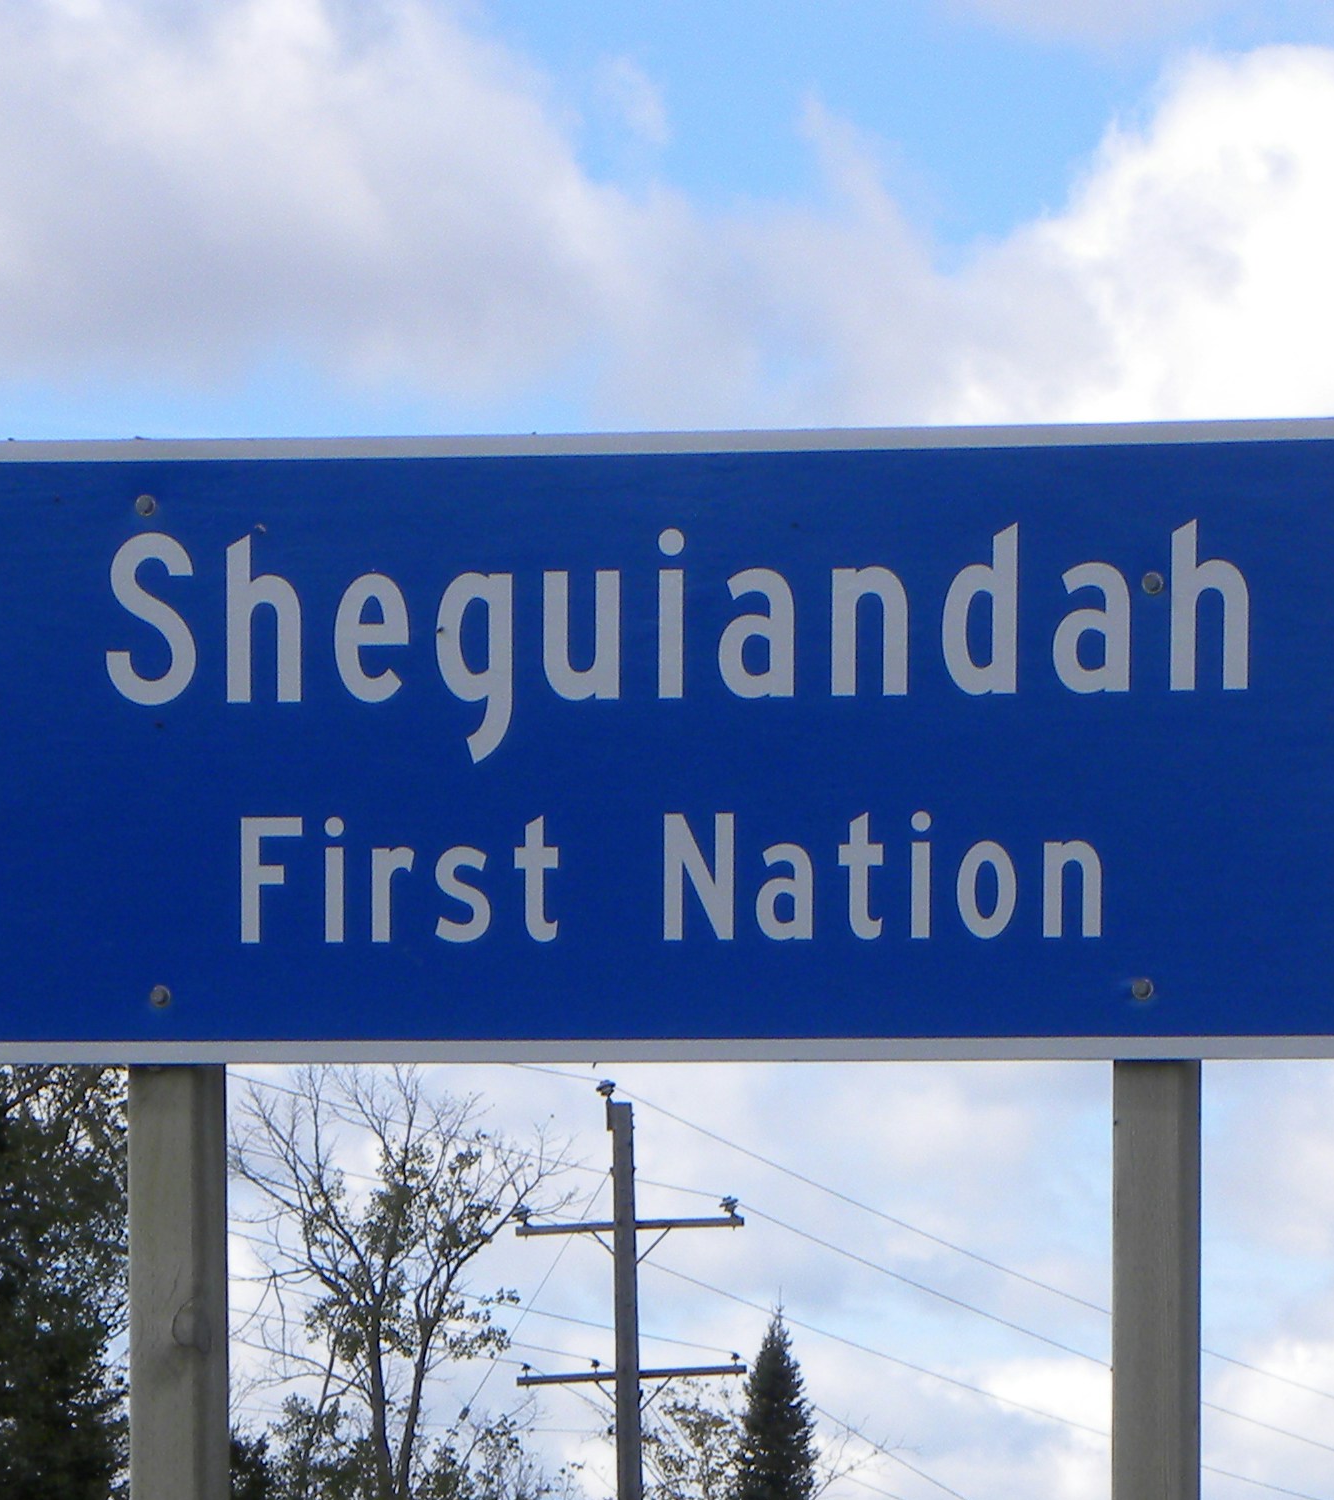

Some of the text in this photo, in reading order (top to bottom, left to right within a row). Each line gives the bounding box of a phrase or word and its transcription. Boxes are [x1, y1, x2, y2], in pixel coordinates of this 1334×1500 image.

[104, 517, 1251, 765] Sheguiandah
[238, 810, 1104, 946] First Nation
